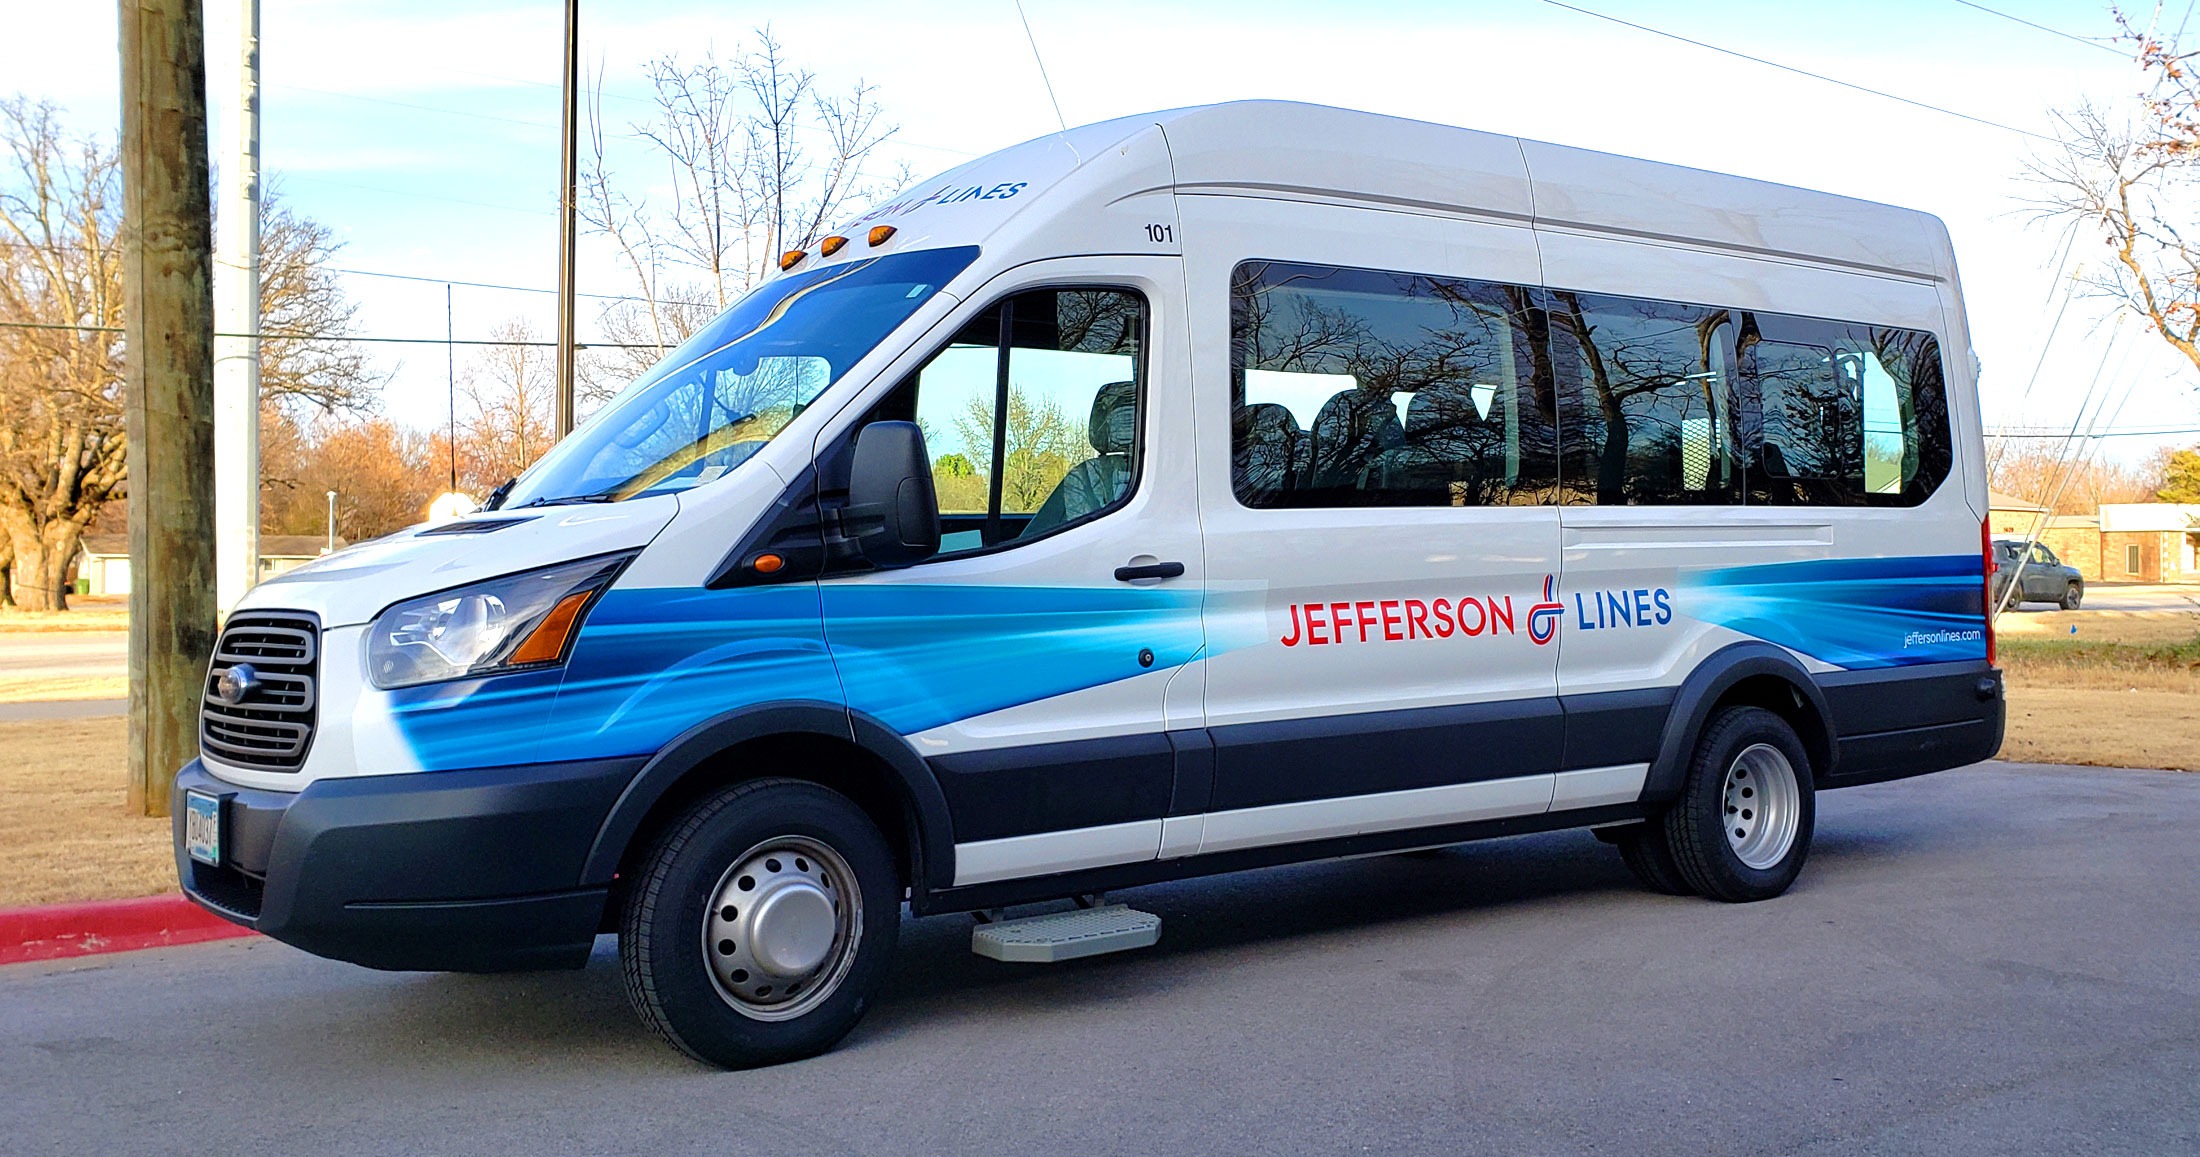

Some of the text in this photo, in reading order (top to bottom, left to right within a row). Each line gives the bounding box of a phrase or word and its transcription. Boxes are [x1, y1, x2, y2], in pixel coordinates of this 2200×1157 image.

[936, 182, 1028, 205] LINES
[1144, 223, 1173, 243] 101
[1280, 587, 1673, 647] JEFFERSON LINES
[1903, 628, 1981, 649] jeffersonlines.com
